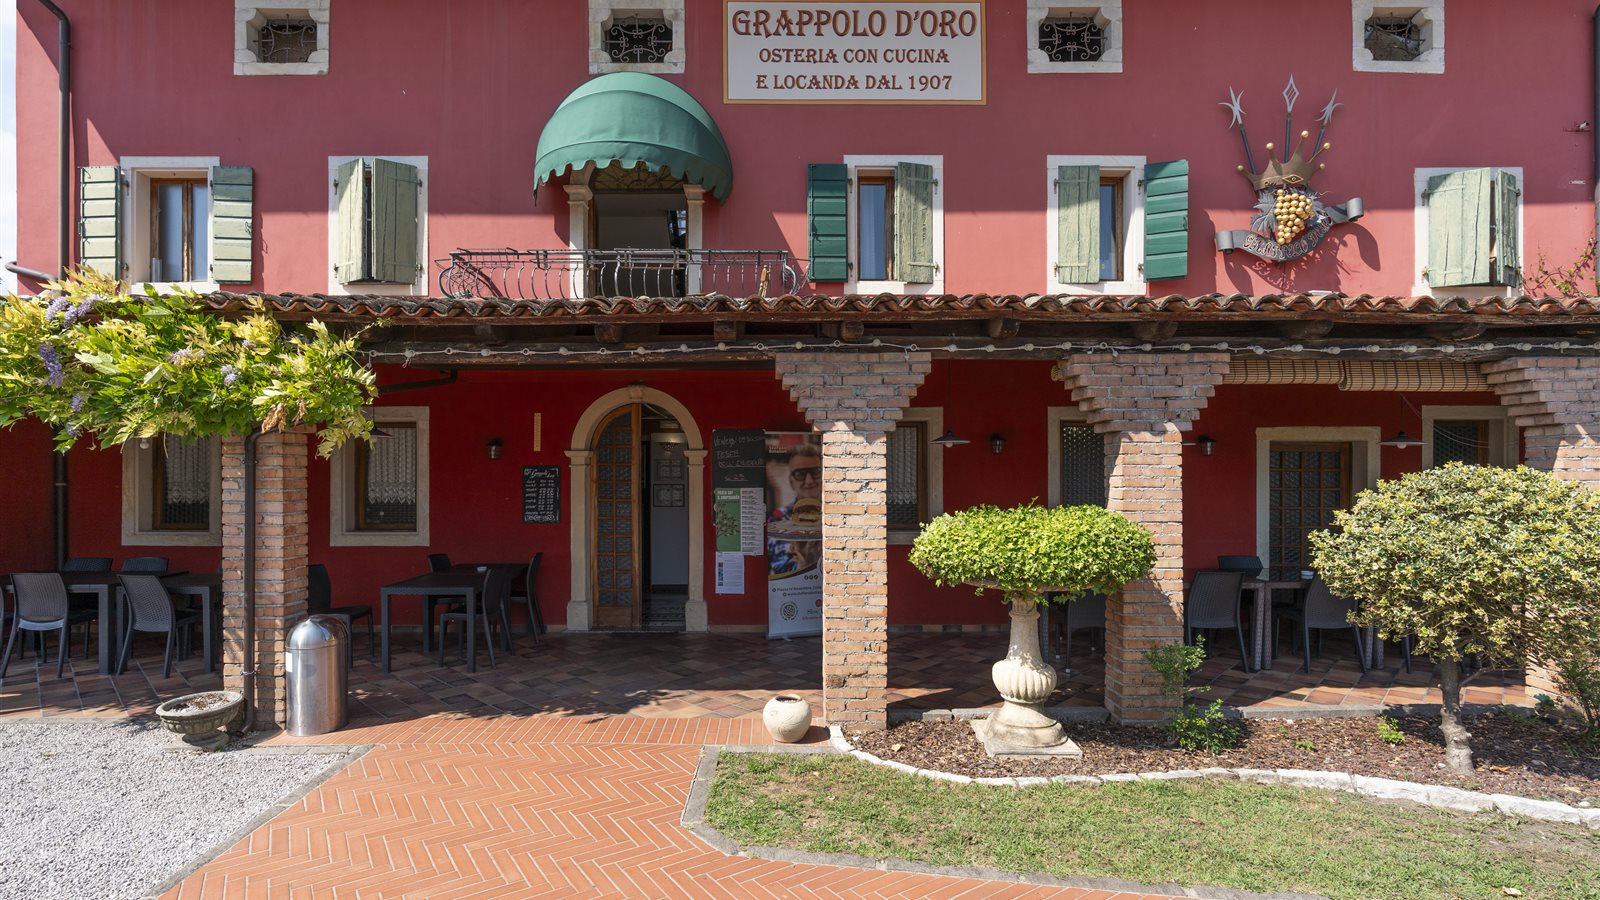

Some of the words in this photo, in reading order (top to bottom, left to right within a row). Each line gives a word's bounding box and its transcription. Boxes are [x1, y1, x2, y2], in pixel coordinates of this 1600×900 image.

[732, 9, 887, 38] GRAPPOLO
[895, 10, 978, 39] D'ORO
[759, 48, 839, 64] OSTERIA
[843, 48, 878, 63] CON
[883, 48, 950, 63] CUCINA
[755, 74, 767, 89] E
[773, 74, 859, 90] LOCANDA
[865, 74, 902, 90] DAL
[908, 75, 953, 91] 1907
